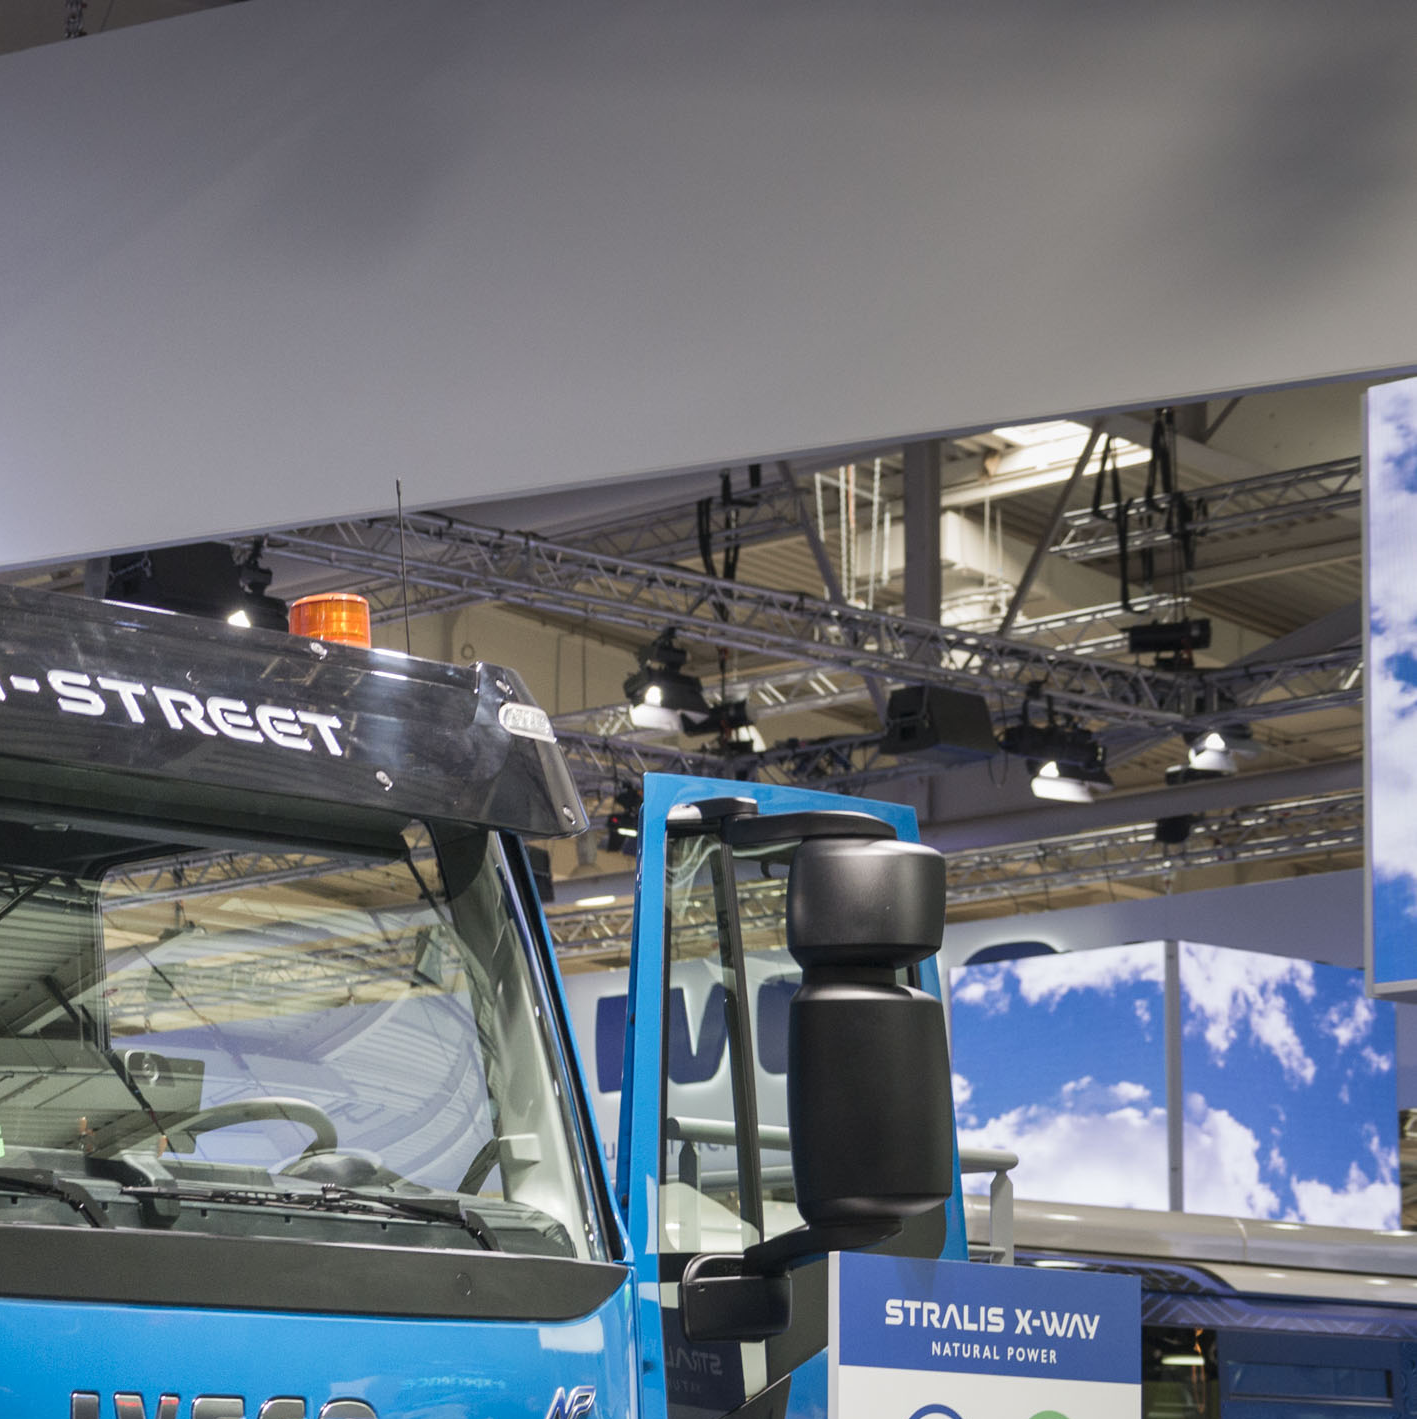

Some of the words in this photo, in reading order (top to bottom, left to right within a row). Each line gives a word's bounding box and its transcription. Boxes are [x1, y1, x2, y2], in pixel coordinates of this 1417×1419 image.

[885, 1299, 1005, 1333] STRALIS
[1015, 1309, 1101, 1340] X-WAY
[931, 1341, 1001, 1360] NATURAL
[1007, 1347, 1058, 1364] POWER
